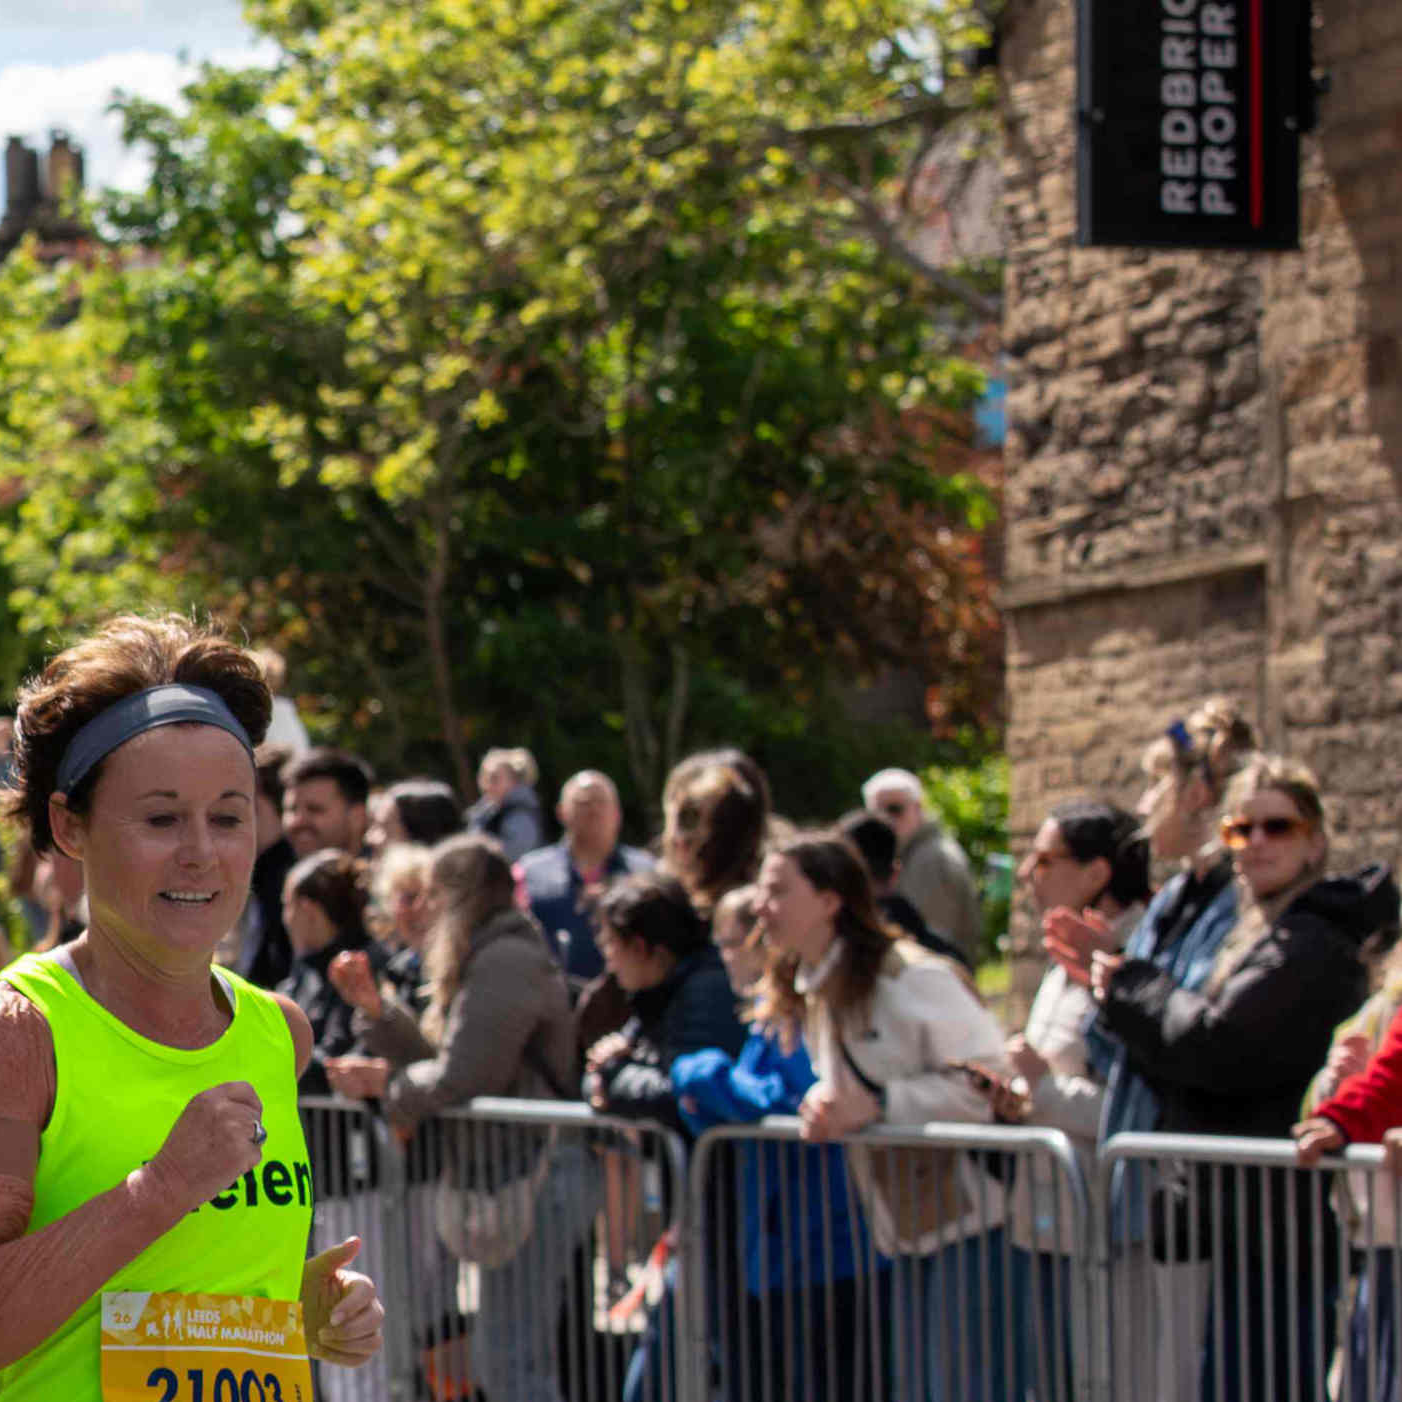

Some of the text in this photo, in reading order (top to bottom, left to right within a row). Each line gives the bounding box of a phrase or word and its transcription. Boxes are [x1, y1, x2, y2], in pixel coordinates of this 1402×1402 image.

[1200, 2, 1237, 216] PROPER
[186, 1309, 221, 1324] LEEDS
[186, 1324, 286, 1346] HALF MARATHON
